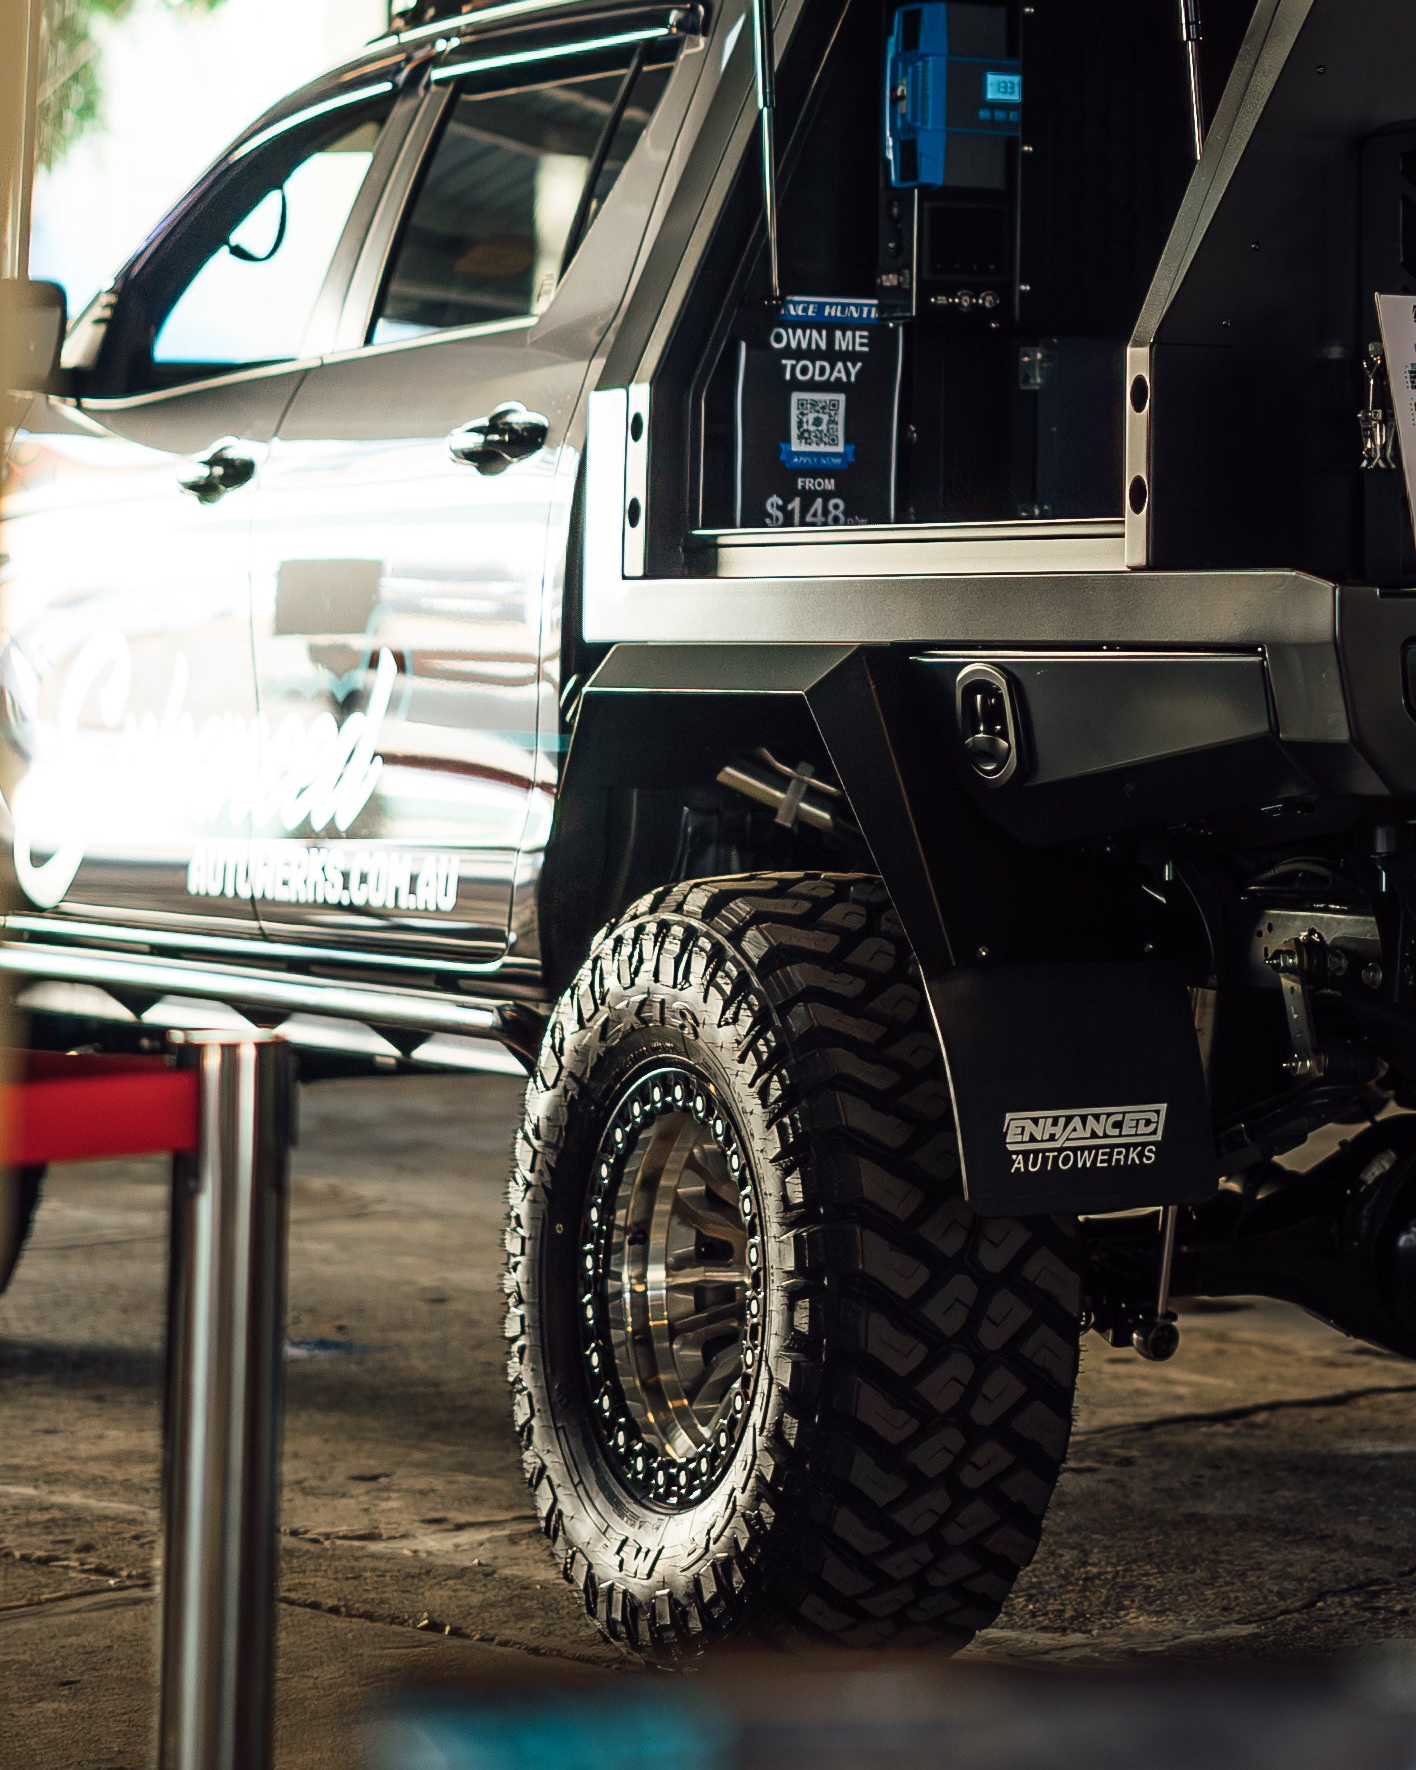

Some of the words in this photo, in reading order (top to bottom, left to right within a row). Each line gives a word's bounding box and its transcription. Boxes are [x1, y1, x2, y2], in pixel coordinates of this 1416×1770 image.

[770, 328, 827, 350] OWN
[834, 330, 870, 352] ME
[781, 359, 862, 382] TODAY
[797, 477, 835, 491] FROM
[765, 494, 846, 527] $148
[188, 844, 461, 912] AUTOWERKS.COM.AU
[1005, 1111, 1160, 1144] ENHANCED
[1011, 1145, 1157, 1173] AUTOWERKS
